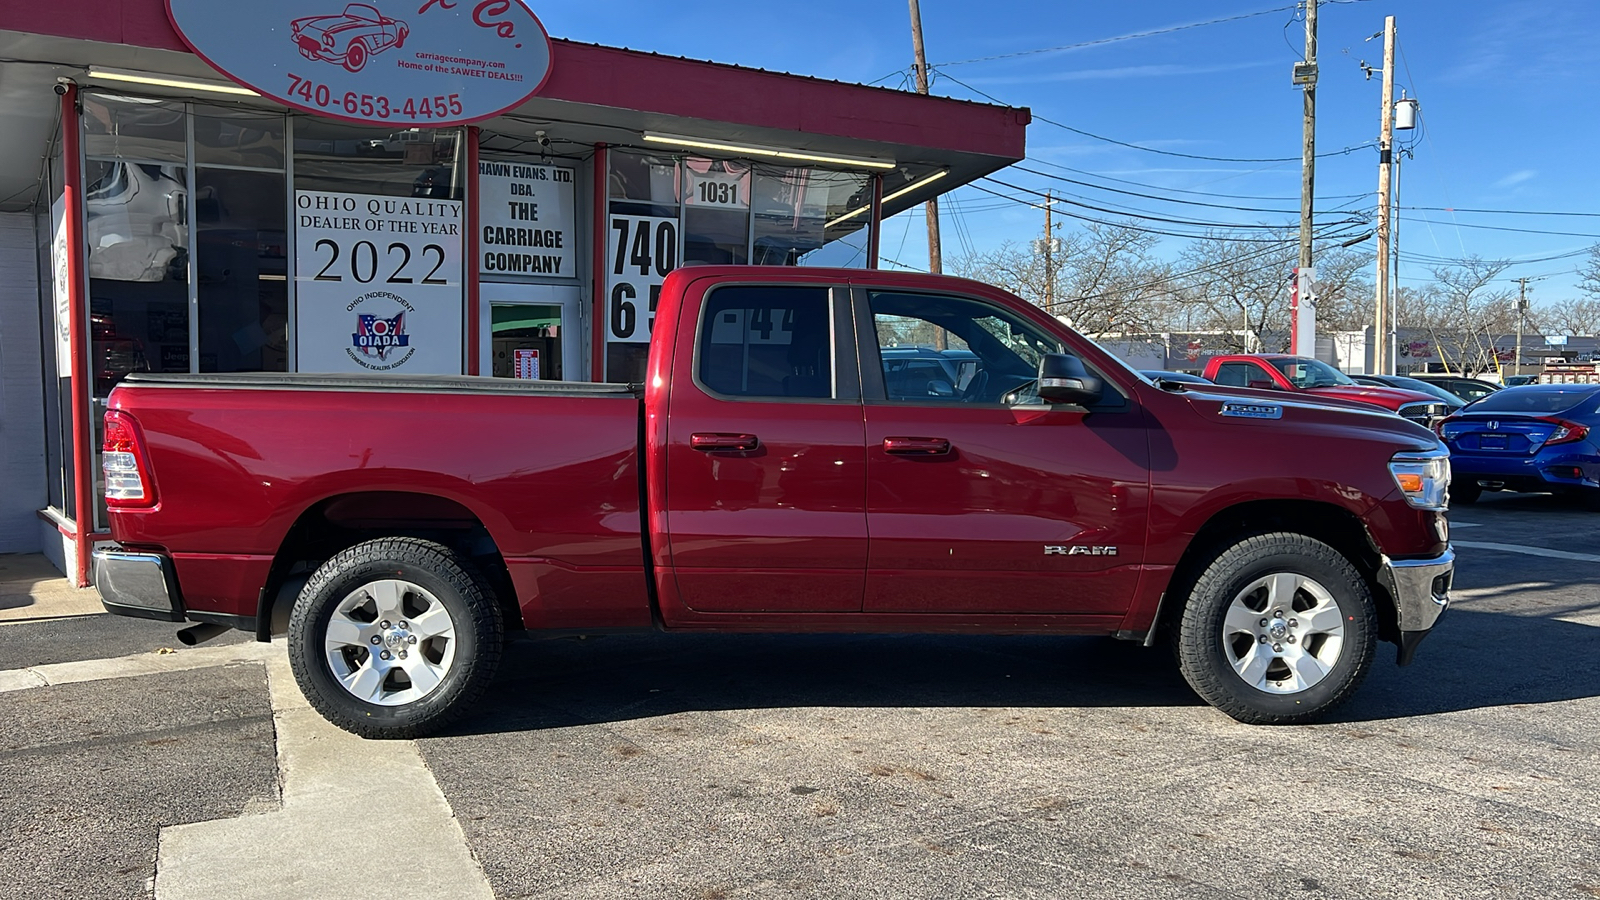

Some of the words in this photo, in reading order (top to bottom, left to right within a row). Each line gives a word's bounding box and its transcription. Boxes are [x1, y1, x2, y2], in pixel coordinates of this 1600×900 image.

[397, 60, 422, 70] Home
[424, 64, 433, 72] of
[435, 65, 449, 73] the
[450, 66, 487, 78] SAWEET
[487, 71, 523, 82] DEALS!!!
[415, 52, 506, 69] carriagecompany.com
[287, 73, 463, 119] 740-653-4455
[513, 165, 549, 181] EVANS.
[552, 169, 573, 183] LTD.
[510, 183, 535, 197] DBA.
[698, 181, 737, 204] 1031
[297, 195, 356, 212] OHIO
[367, 199, 461, 218] QUALITY
[508, 201, 538, 221] THE
[300, 215, 361, 230] DEALER
[364, 218, 385, 231] OF
[388, 220, 418, 233] THE
[420, 222, 459, 235] YEAR
[483, 225, 563, 249] CARRIAGE
[612, 218, 676, 278] 740
[313, 238, 447, 285] 2022
[484, 252, 562, 274] COMPANY
[346, 296, 364, 312] OHIO
[364, 291, 415, 313] INDEPENDENT
[359, 335, 400, 346] OIADA
[163, 352, 189, 362] Jeep
[345, 347, 370, 370] AUTOMOBILE
[391, 347, 416, 369] ASSOCIATION
[1044, 545, 1117, 555] RAM
